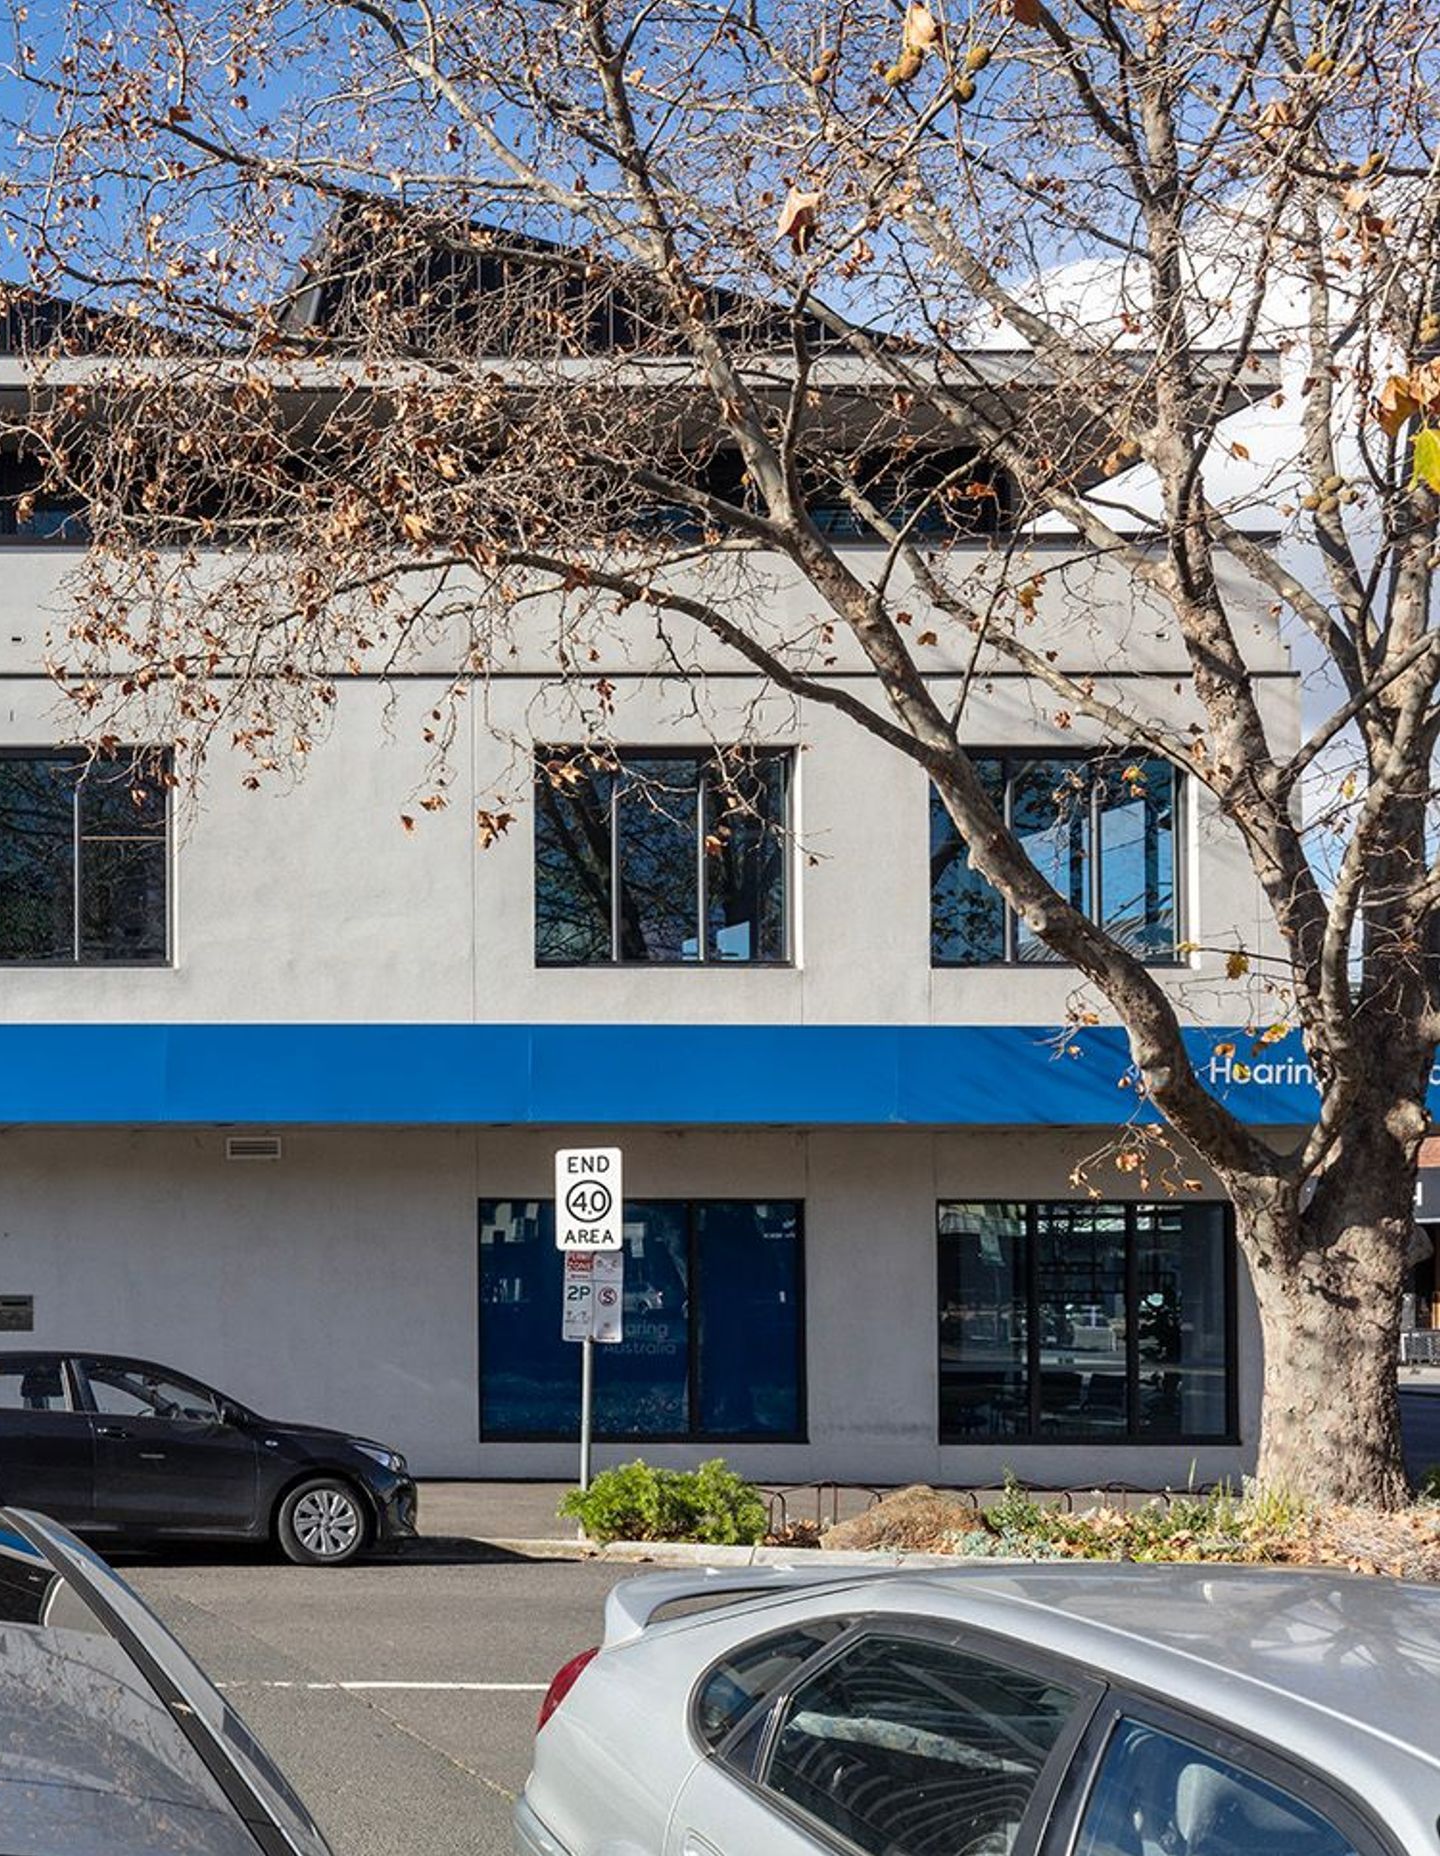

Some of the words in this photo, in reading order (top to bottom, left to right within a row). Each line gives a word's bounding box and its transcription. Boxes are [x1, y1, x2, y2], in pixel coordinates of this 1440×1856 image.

[1210, 1056, 1322, 1090] Harin
[567, 1155, 610, 1173] END
[571, 1190, 606, 1212] 40
[564, 1229, 614, 1244] AREA
[567, 1285, 591, 1301] 2P
[624, 1320, 668, 1342] aring
